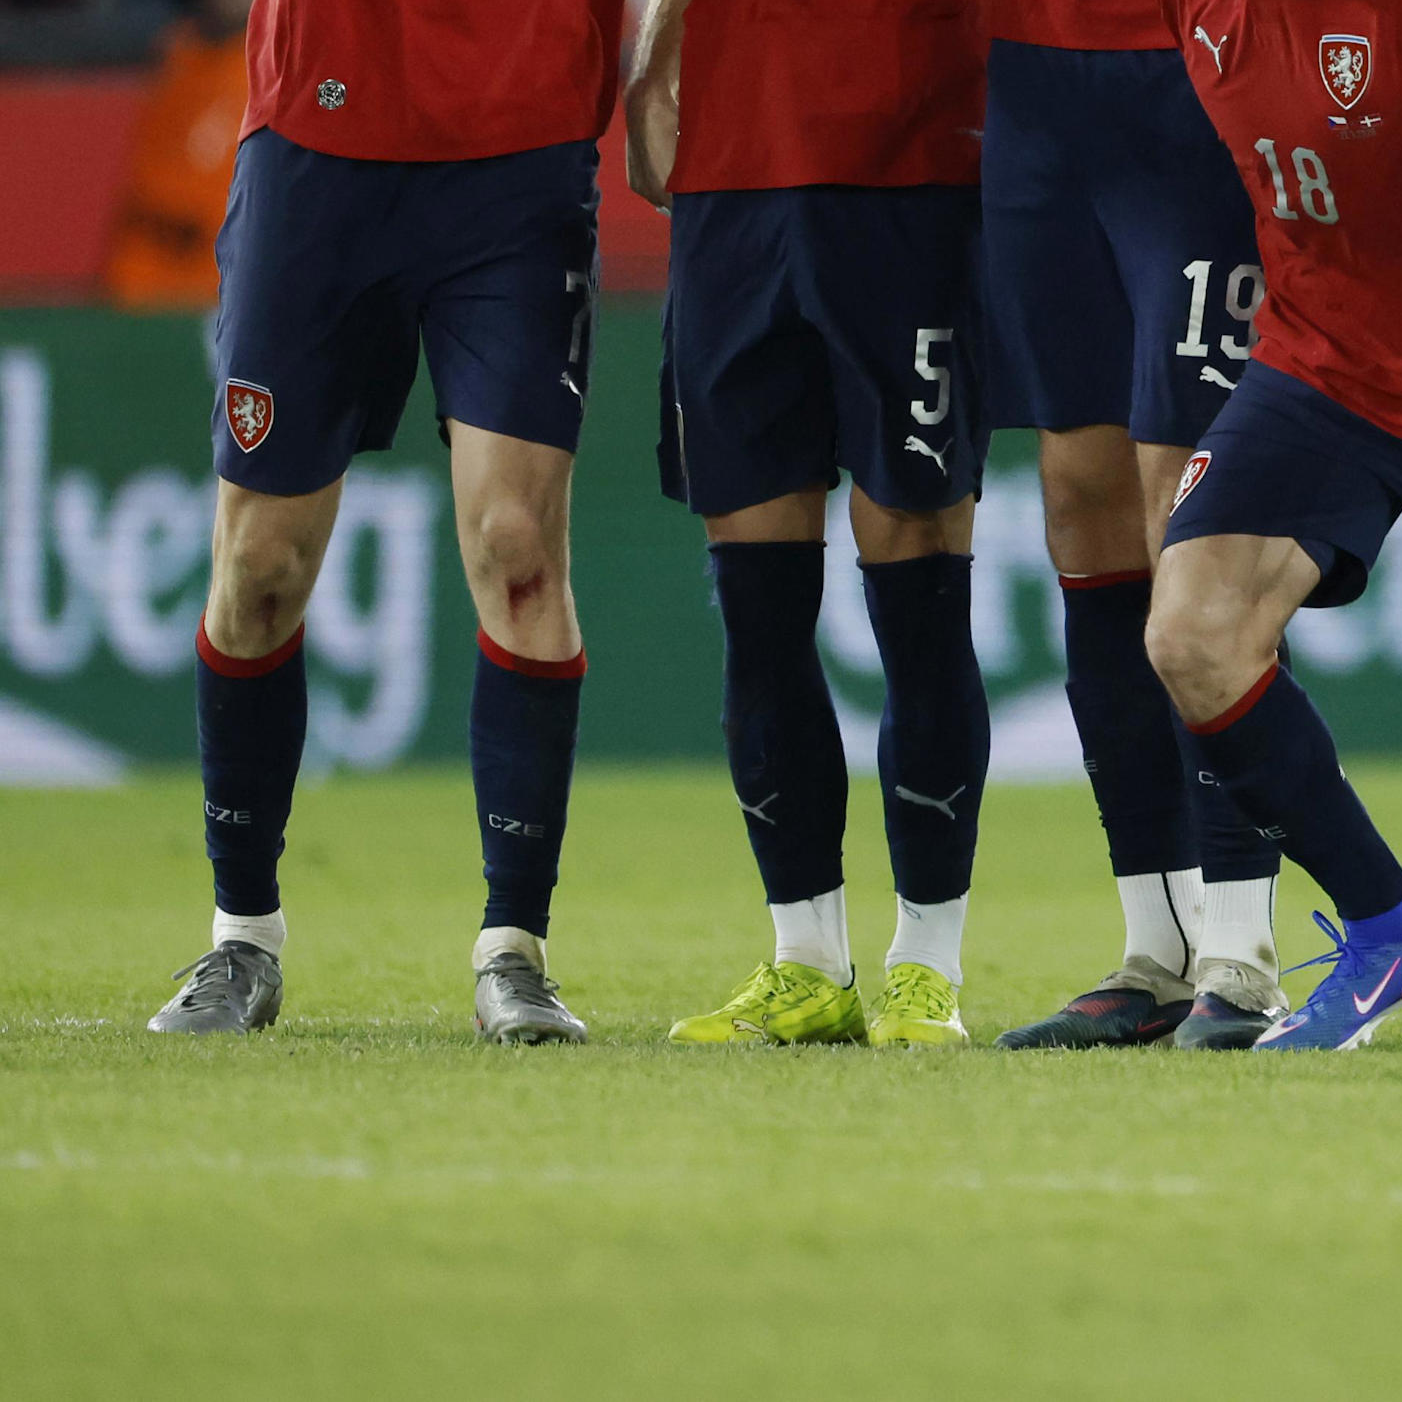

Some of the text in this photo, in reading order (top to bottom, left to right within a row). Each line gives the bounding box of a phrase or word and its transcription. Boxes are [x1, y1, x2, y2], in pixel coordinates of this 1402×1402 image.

[1254, 137, 1338, 224] 18
[1175, 259, 1265, 360] 19
[910, 327, 953, 427] 5
[205, 800, 251, 824] CZE
[488, 813, 544, 838] CZE
